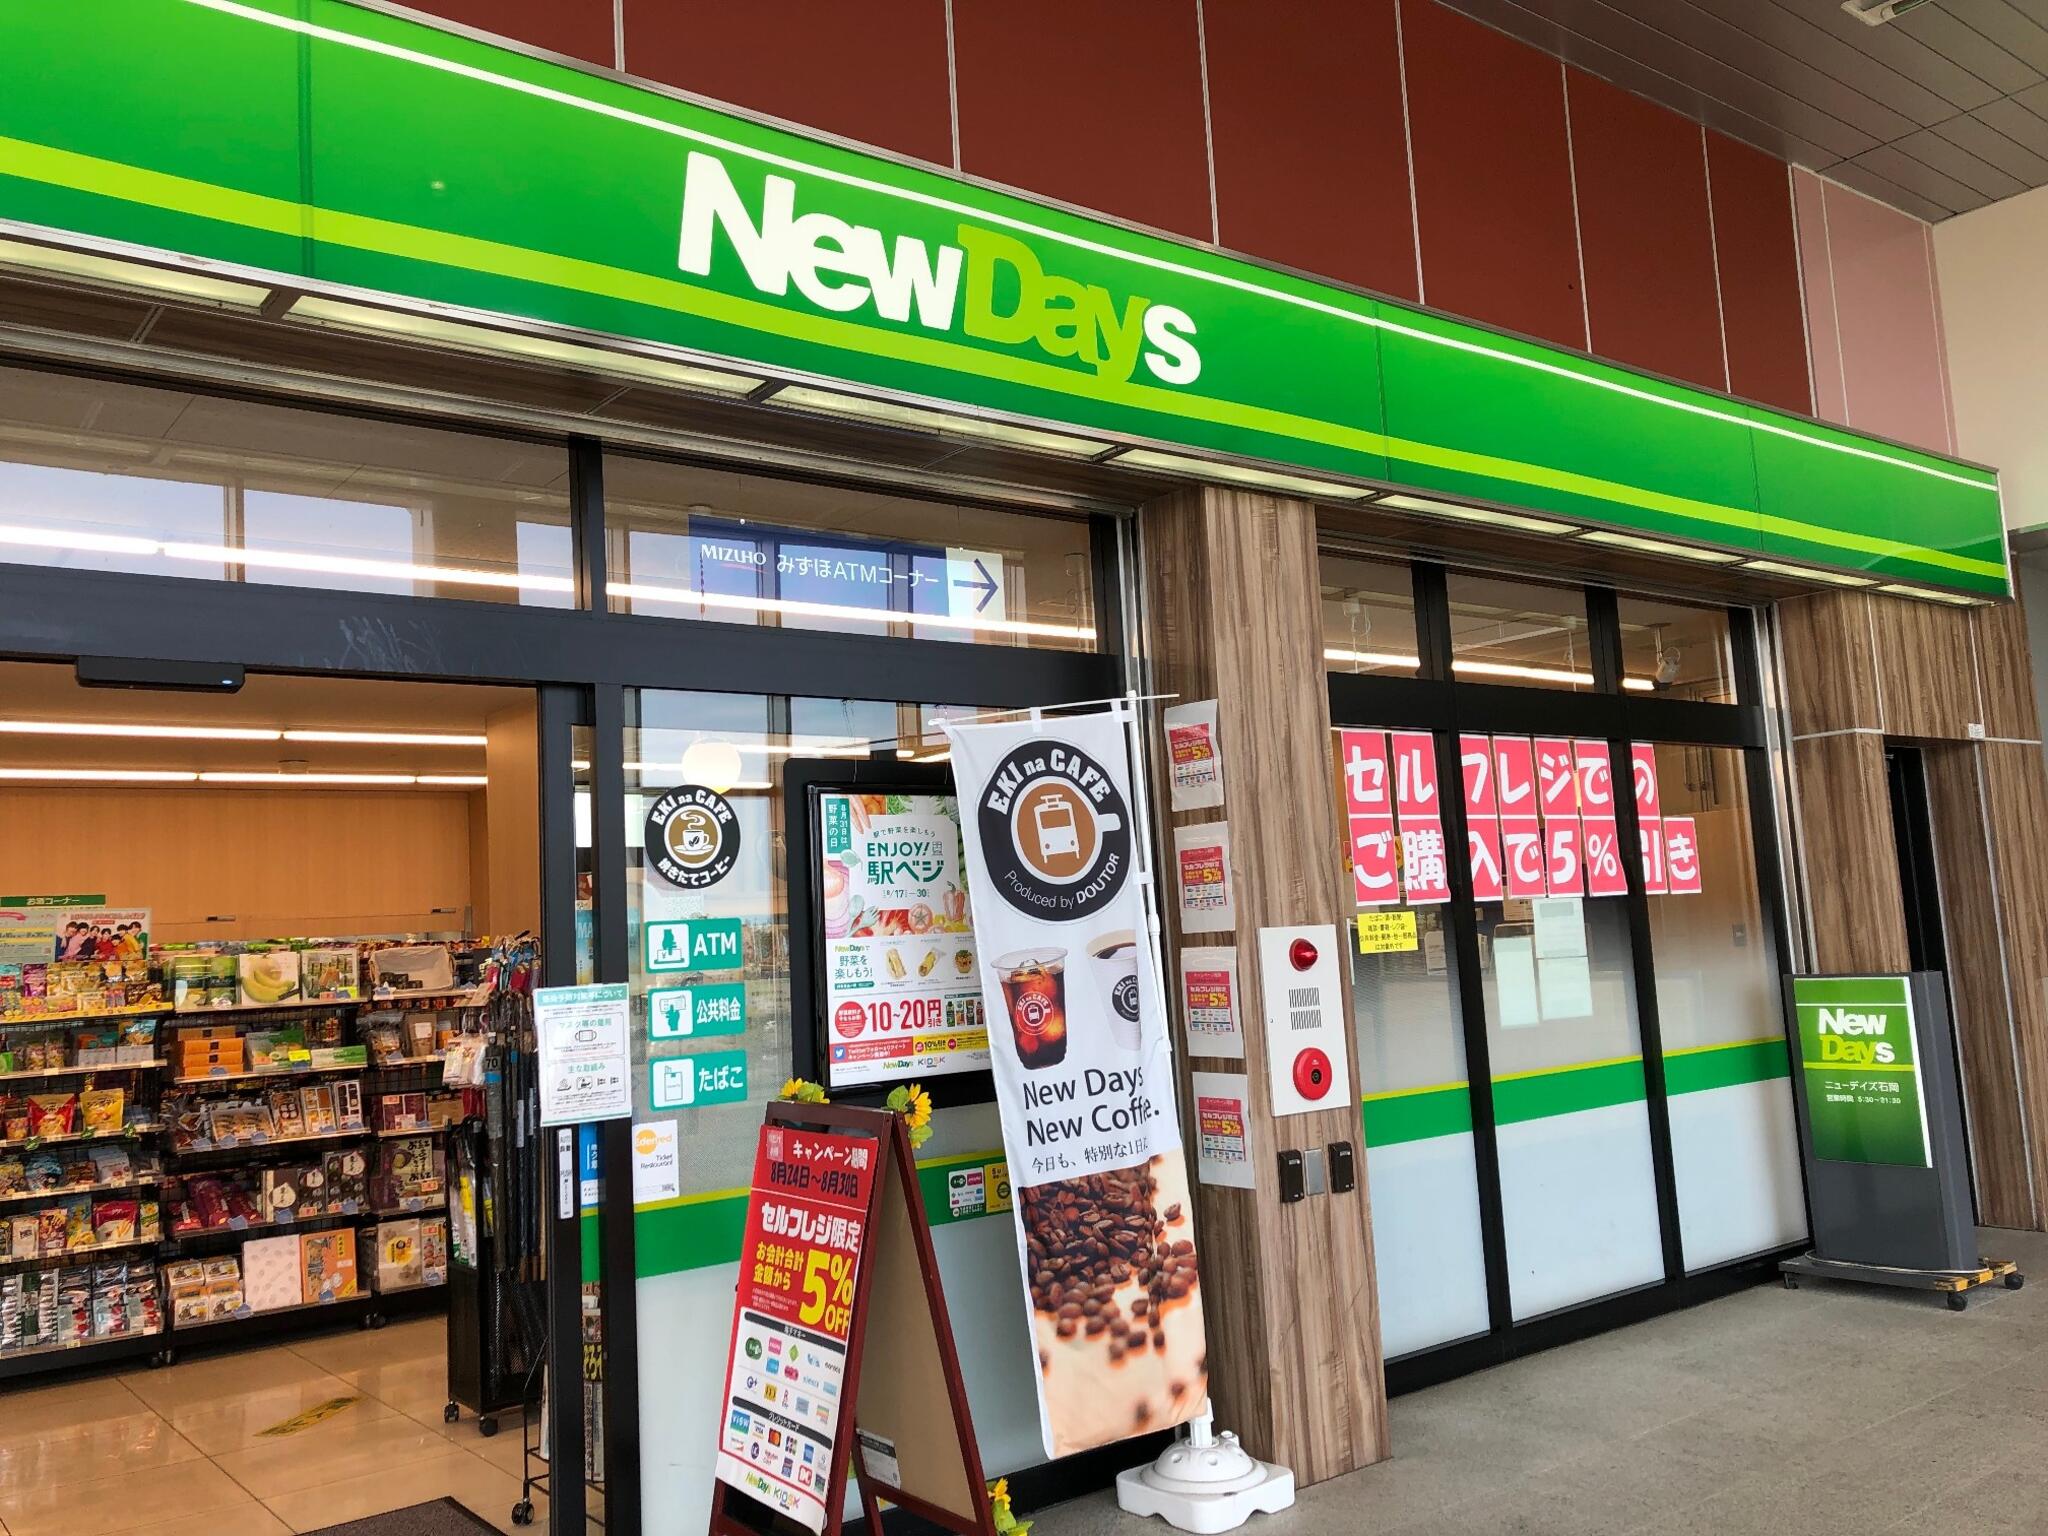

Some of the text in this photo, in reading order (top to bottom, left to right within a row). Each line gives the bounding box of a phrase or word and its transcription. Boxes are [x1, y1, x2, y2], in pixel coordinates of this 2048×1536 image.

[678, 151, 1201, 385] NewDays
[700, 543, 939, 587] MIZUHO みずほATMコーナー
[986, 748, 1111, 815] EKI na CAFE
[651, 789, 733, 826] EKI na CAFE
[828, 804, 838, 847] 野菜の日
[866, 842, 930, 857] ENJOY!
[866, 860, 945, 885] 駅ベジ
[1003, 852, 1120, 910] Produced by DOUTOR
[693, 932, 737, 957] ATM
[696, 997, 741, 1024] 公共料金
[1818, 1008, 1887, 1035] New
[1819, 1034, 1896, 1065] Days
[698, 1064, 744, 1094] たばこ
[1022, 1066, 1144, 1110] New Days
[1026, 1116, 1083, 1147] New
[792, 1139, 869, 1171] キャンペーン期間
[761, 1201, 861, 1254] セルフレジ限定
[756, 1241, 805, 1273] お会計合計
[752, 1262, 792, 1291] 金額から
[824, 1303, 851, 1336] OFF
